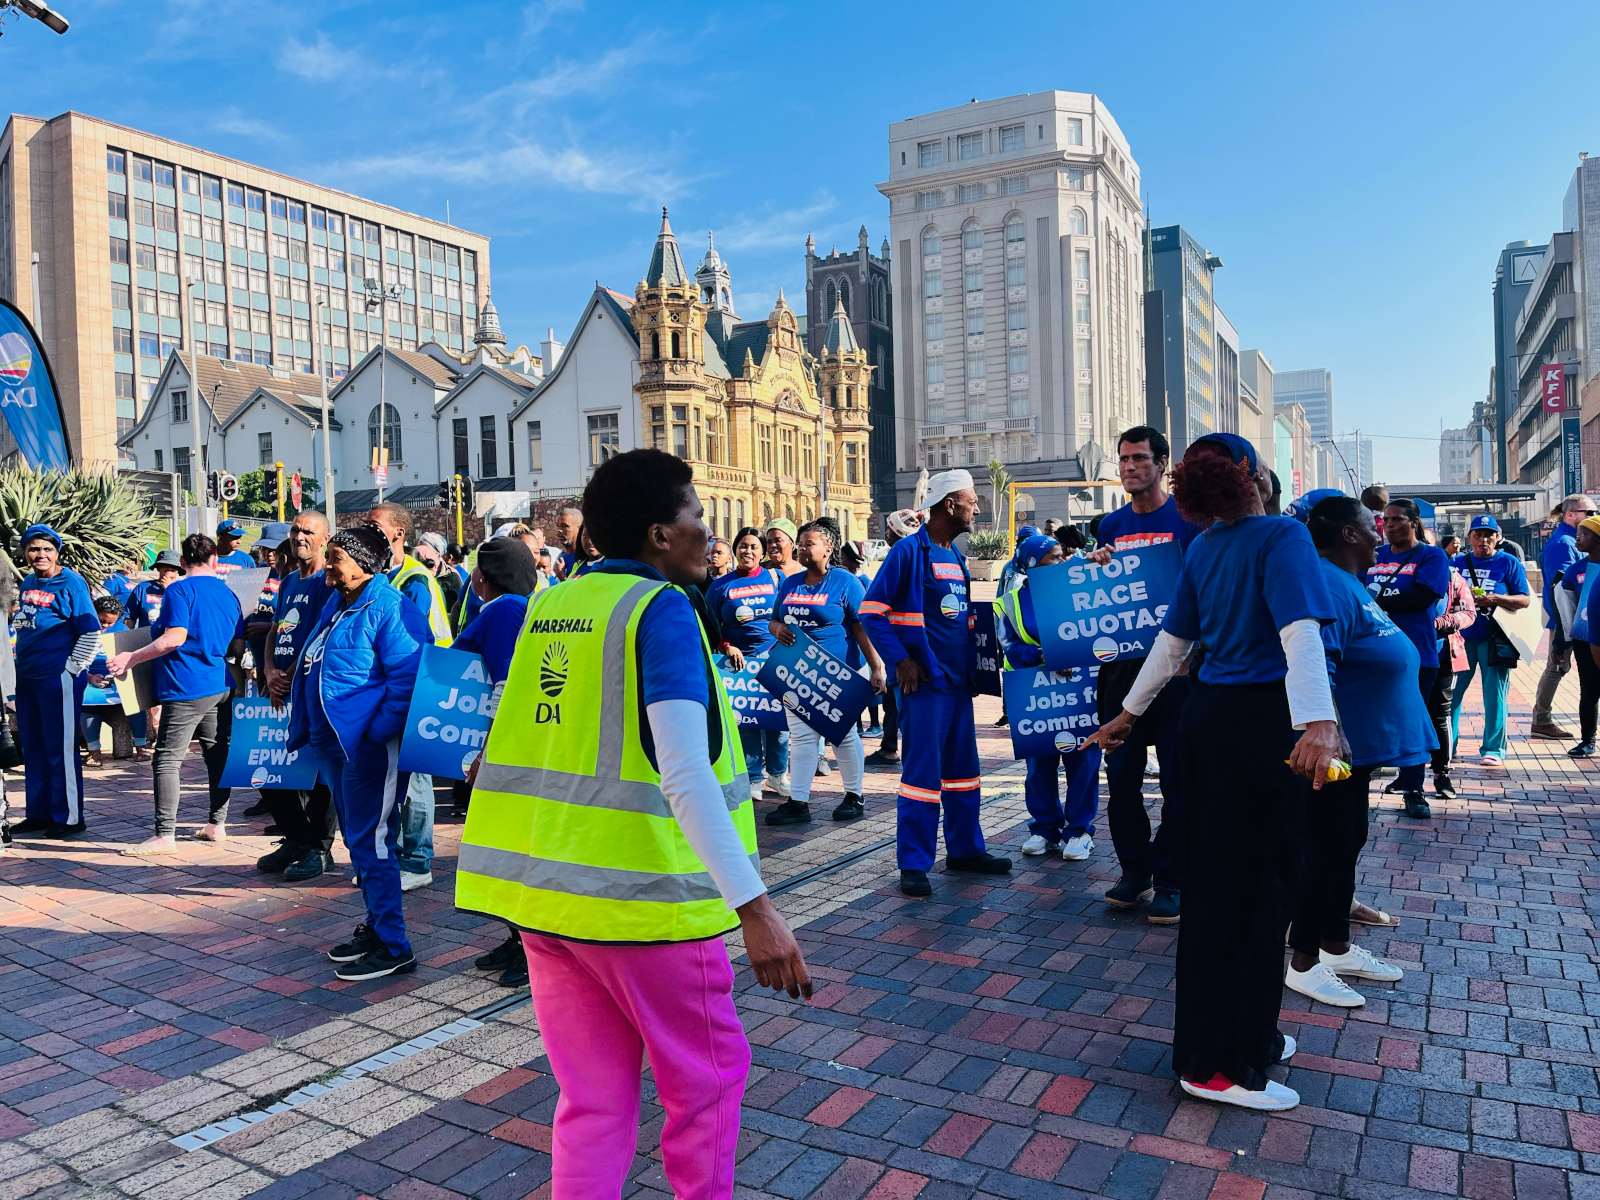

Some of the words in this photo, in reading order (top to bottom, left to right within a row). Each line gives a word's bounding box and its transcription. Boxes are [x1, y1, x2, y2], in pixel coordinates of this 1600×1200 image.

[1545, 369, 1562, 407] KFC
[1067, 555, 1141, 585] STOP
[949, 583, 967, 595] Vote
[1071, 580, 1149, 612] RACE
[1382, 587, 1401, 597] DA
[258, 603, 275, 614] DA
[741, 597, 766, 606] Vote
[754, 608, 773, 616] DA
[787, 606, 810, 616] Vote
[529, 618, 594, 634] MARSHALL
[1057, 604, 1170, 641] QUOTAS
[1119, 639, 1145, 654] DA
[804, 644, 852, 681] STOP
[793, 657, 843, 701] RACE
[775, 664, 844, 723] QUOTAS
[1025, 691, 1079, 712] Jobs
[534, 702, 561, 725] DA
[741, 716, 759, 725] DA
[795, 704, 812, 721] DA
[247, 748, 300, 766] EPWP
[266, 774, 282, 784] DA
